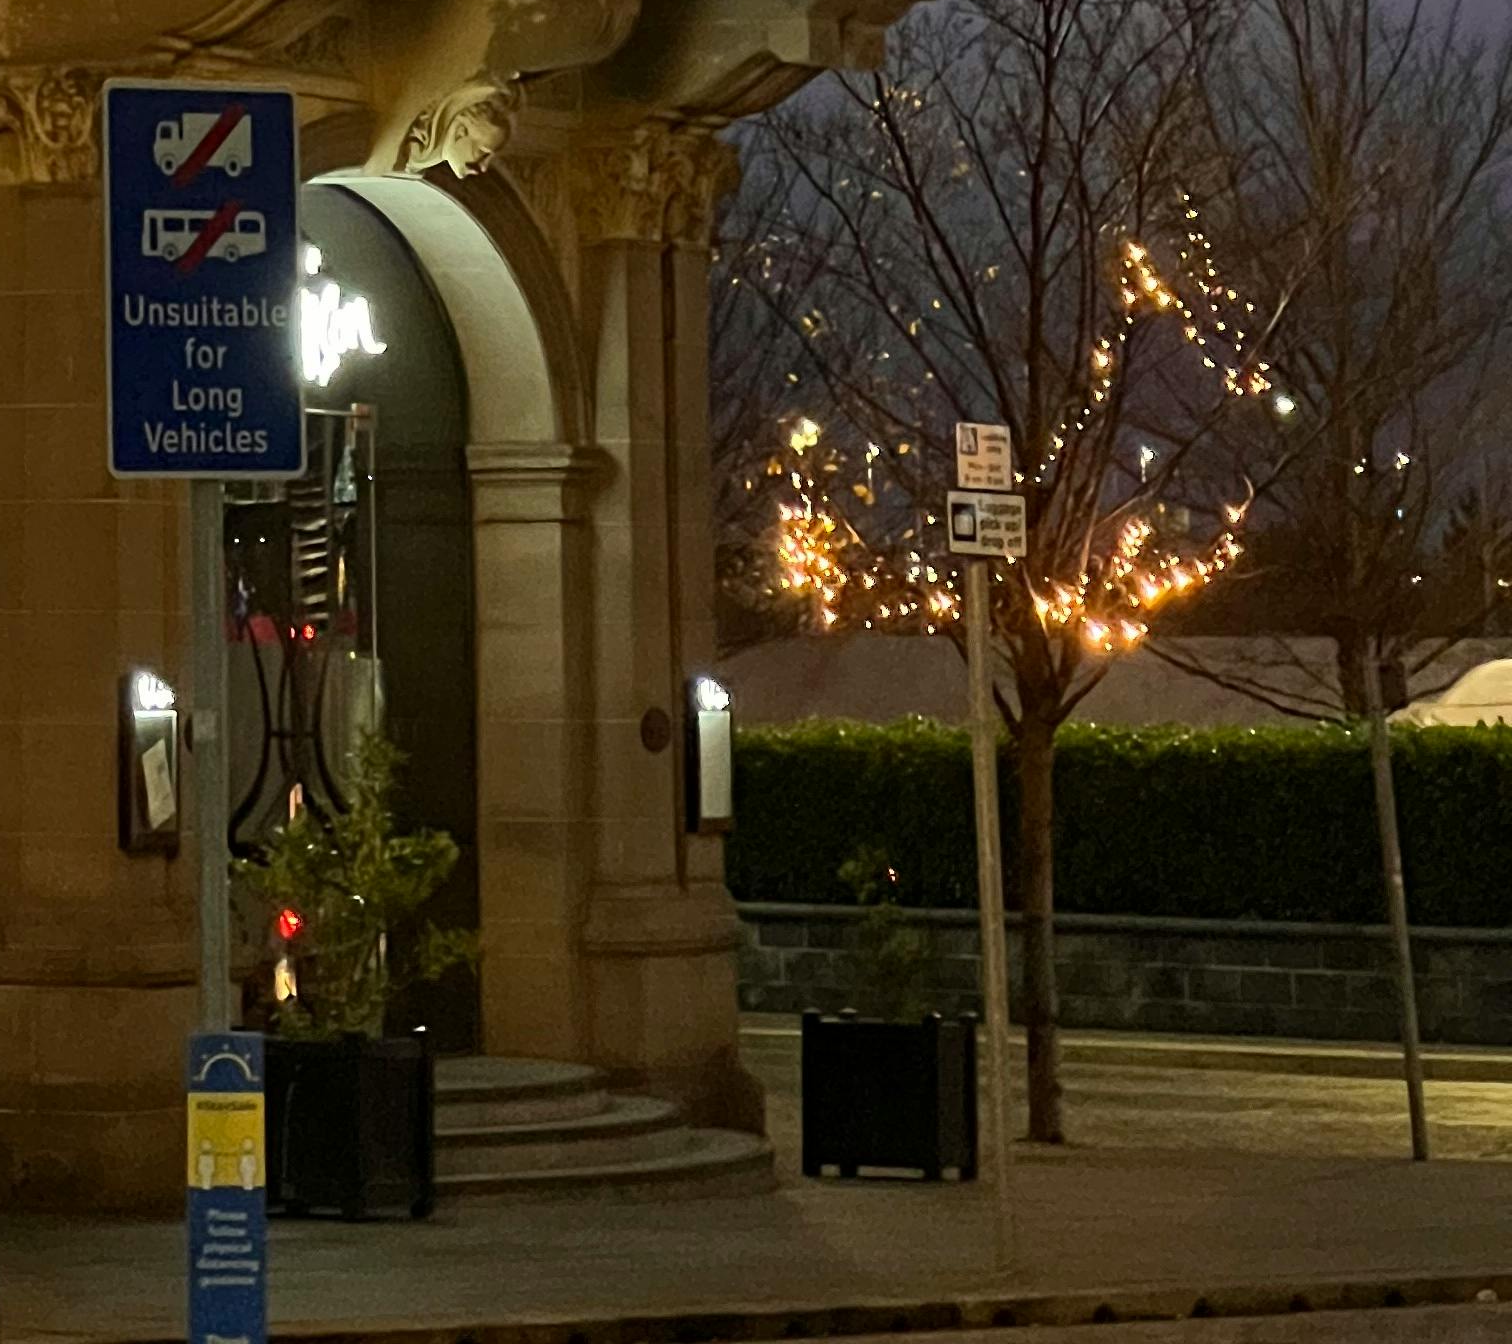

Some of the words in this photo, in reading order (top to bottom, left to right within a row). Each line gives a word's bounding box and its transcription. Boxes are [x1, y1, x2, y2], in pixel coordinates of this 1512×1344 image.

[124, 295, 287, 328] Unsuitable
[185, 338, 227, 369] for
[172, 380, 243, 417] Long
[144, 422, 268, 454] Vehicles
